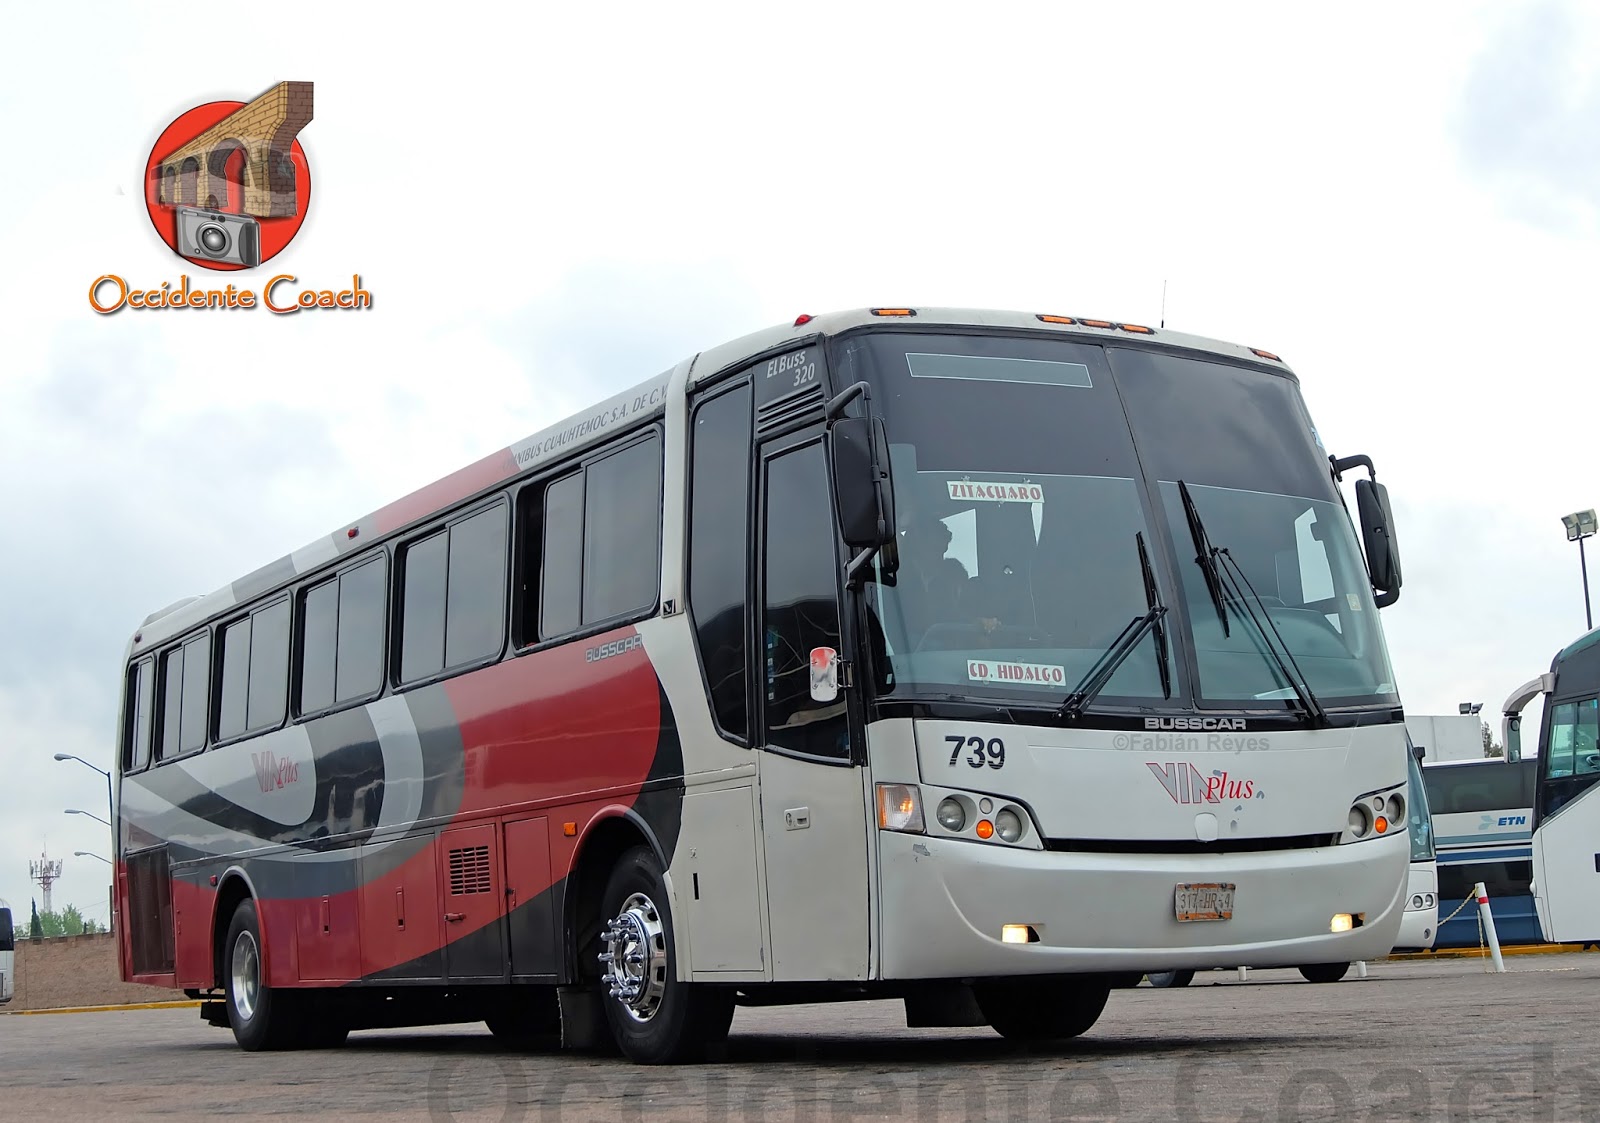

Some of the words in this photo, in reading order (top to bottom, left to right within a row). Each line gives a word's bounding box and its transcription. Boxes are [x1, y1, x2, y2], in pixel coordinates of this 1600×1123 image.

[793, 362, 815, 387] 320
[543, 411, 609, 453] CUAUHTEMOC
[610, 403, 629, 423] S.A.
[632, 393, 648, 413] DE
[950, 484, 1042, 500] ZITACUARO
[585, 633, 643, 663] BUSSCAR
[969, 662, 993, 678] CD.
[997, 664, 1063, 683] HIDALGO
[1144, 717, 1247, 731] BUSSCAR
[944, 735, 1006, 770] 739
[1497, 816, 1526, 826] ETN
